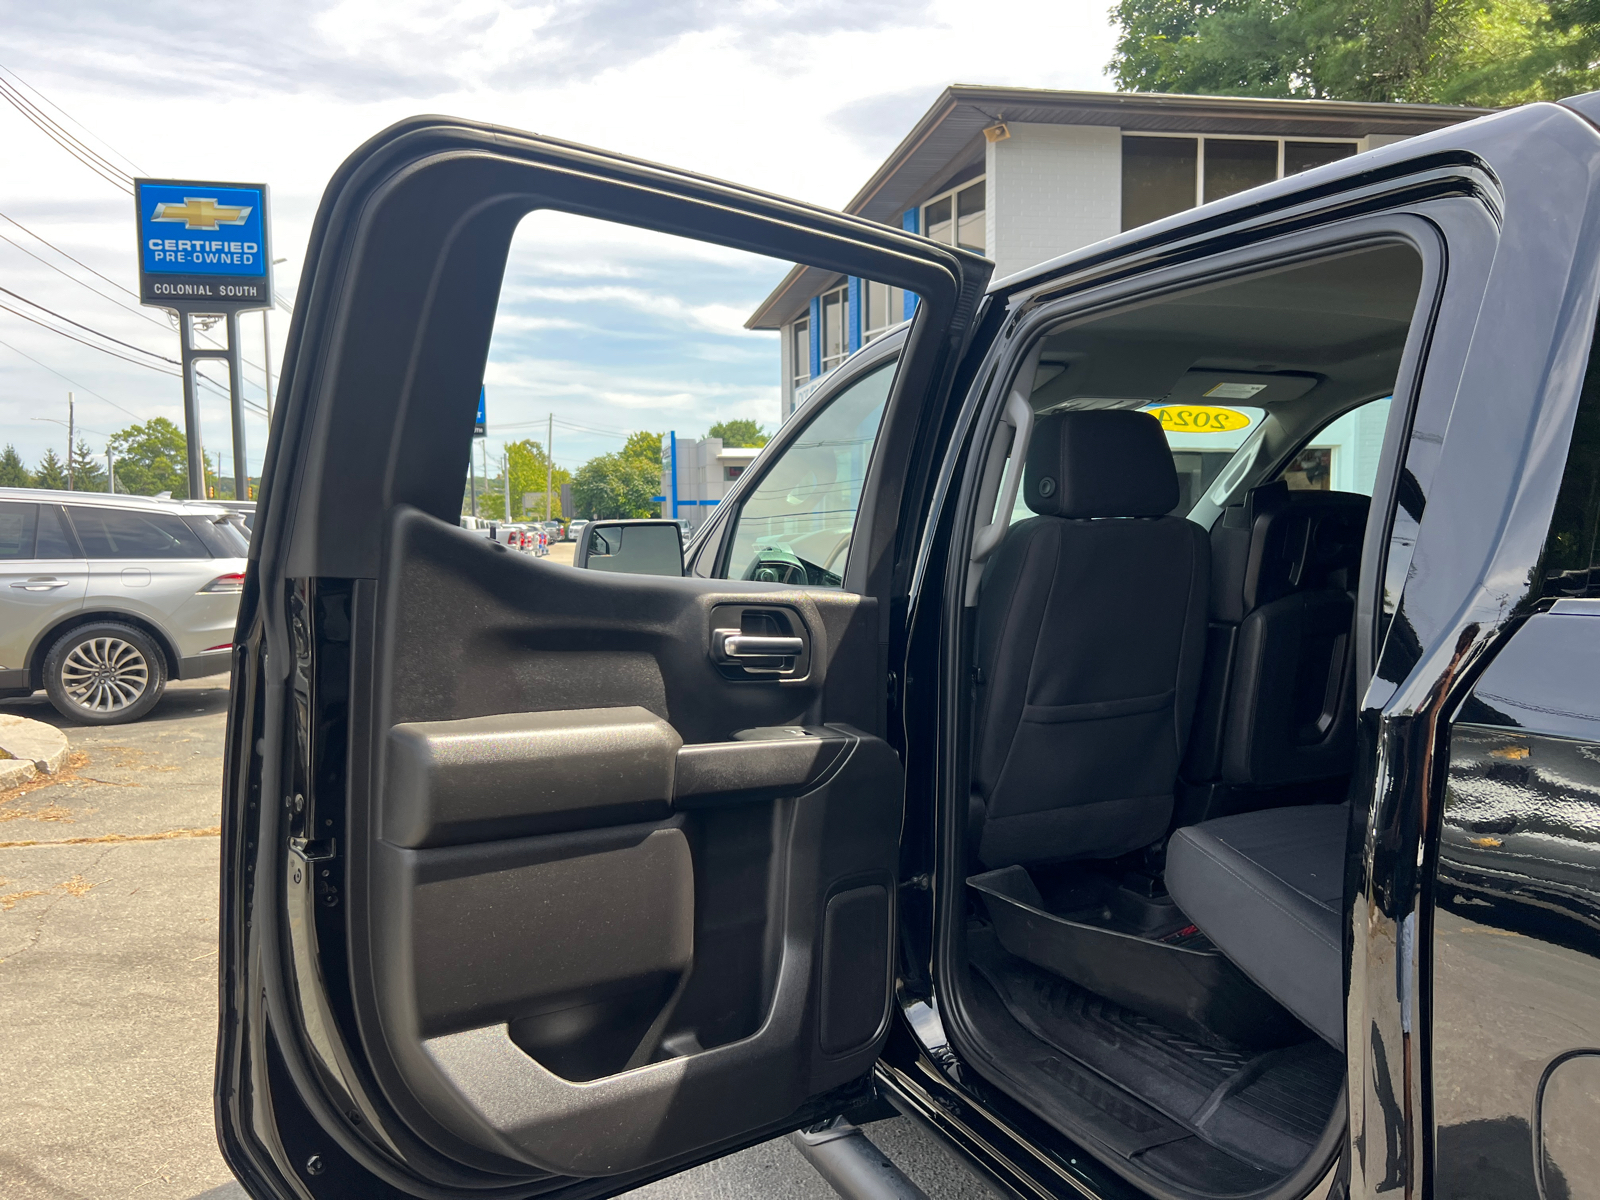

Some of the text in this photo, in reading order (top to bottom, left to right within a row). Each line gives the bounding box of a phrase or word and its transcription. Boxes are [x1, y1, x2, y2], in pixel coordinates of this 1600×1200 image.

[148, 239, 258, 253] CERTIFIED
[154, 251, 253, 265] PRE-OWNED
[154, 283, 257, 296] COLONIAL SOUTH
